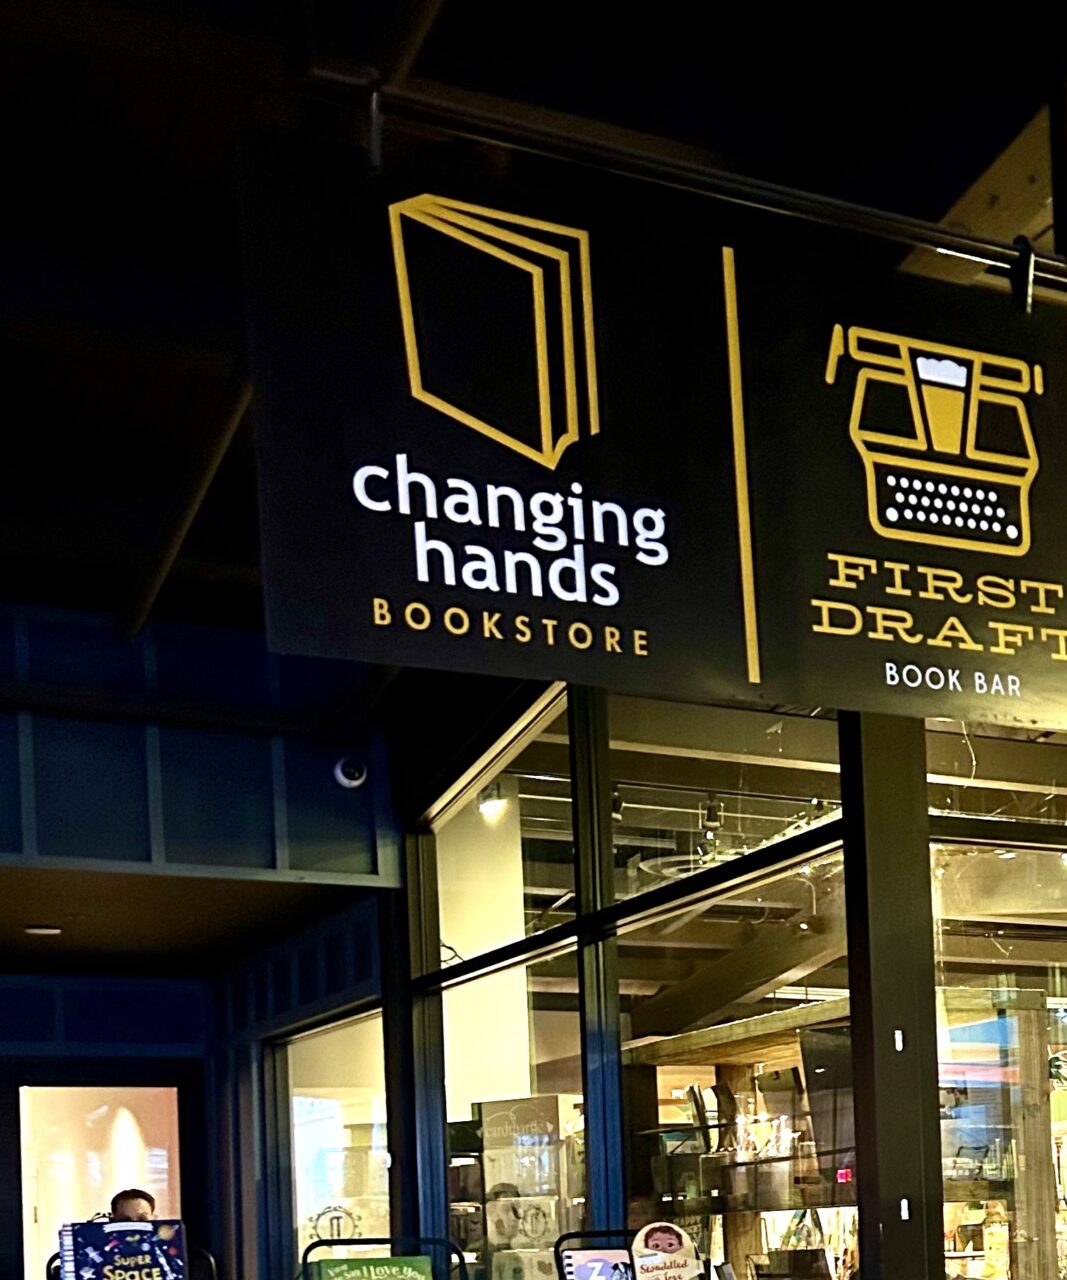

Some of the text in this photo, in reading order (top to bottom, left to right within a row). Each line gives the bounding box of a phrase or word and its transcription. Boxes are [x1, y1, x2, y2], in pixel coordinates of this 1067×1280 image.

[352, 452, 670, 568] changing
[413, 521, 621, 607] hands
[827, 553, 1064, 616] FIRST
[372, 597, 651, 658] BOOKSTORE
[884, 662, 1022, 699] BOOK BAR
[370, 1265, 401, 1280] Love
